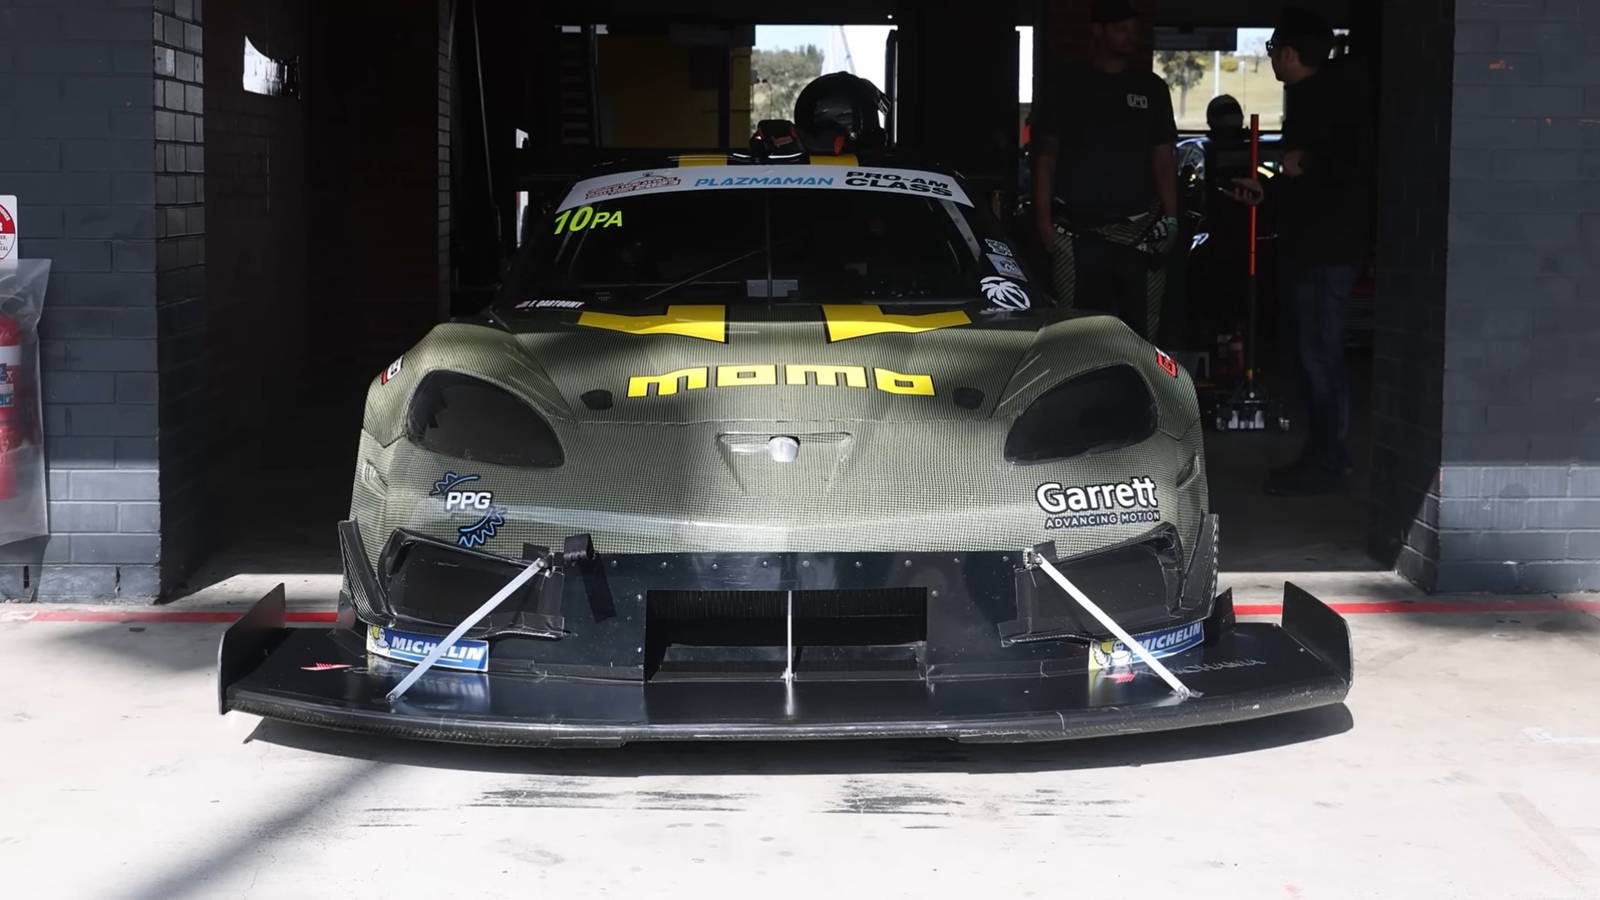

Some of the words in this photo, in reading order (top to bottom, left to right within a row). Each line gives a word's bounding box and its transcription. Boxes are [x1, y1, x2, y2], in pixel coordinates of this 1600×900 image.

[694, 176, 834, 188] PLAZMAMAN
[845, 178, 953, 197] CLASS
[846, 171, 949, 189] PRO-AM
[446, 491, 492, 510] PPG
[1036, 476, 1158, 514] Garrett
[1045, 513, 1118, 529] ADVANCING
[1121, 510, 1160, 524] MOTION
[390, 636, 485, 661] MICHLIN
